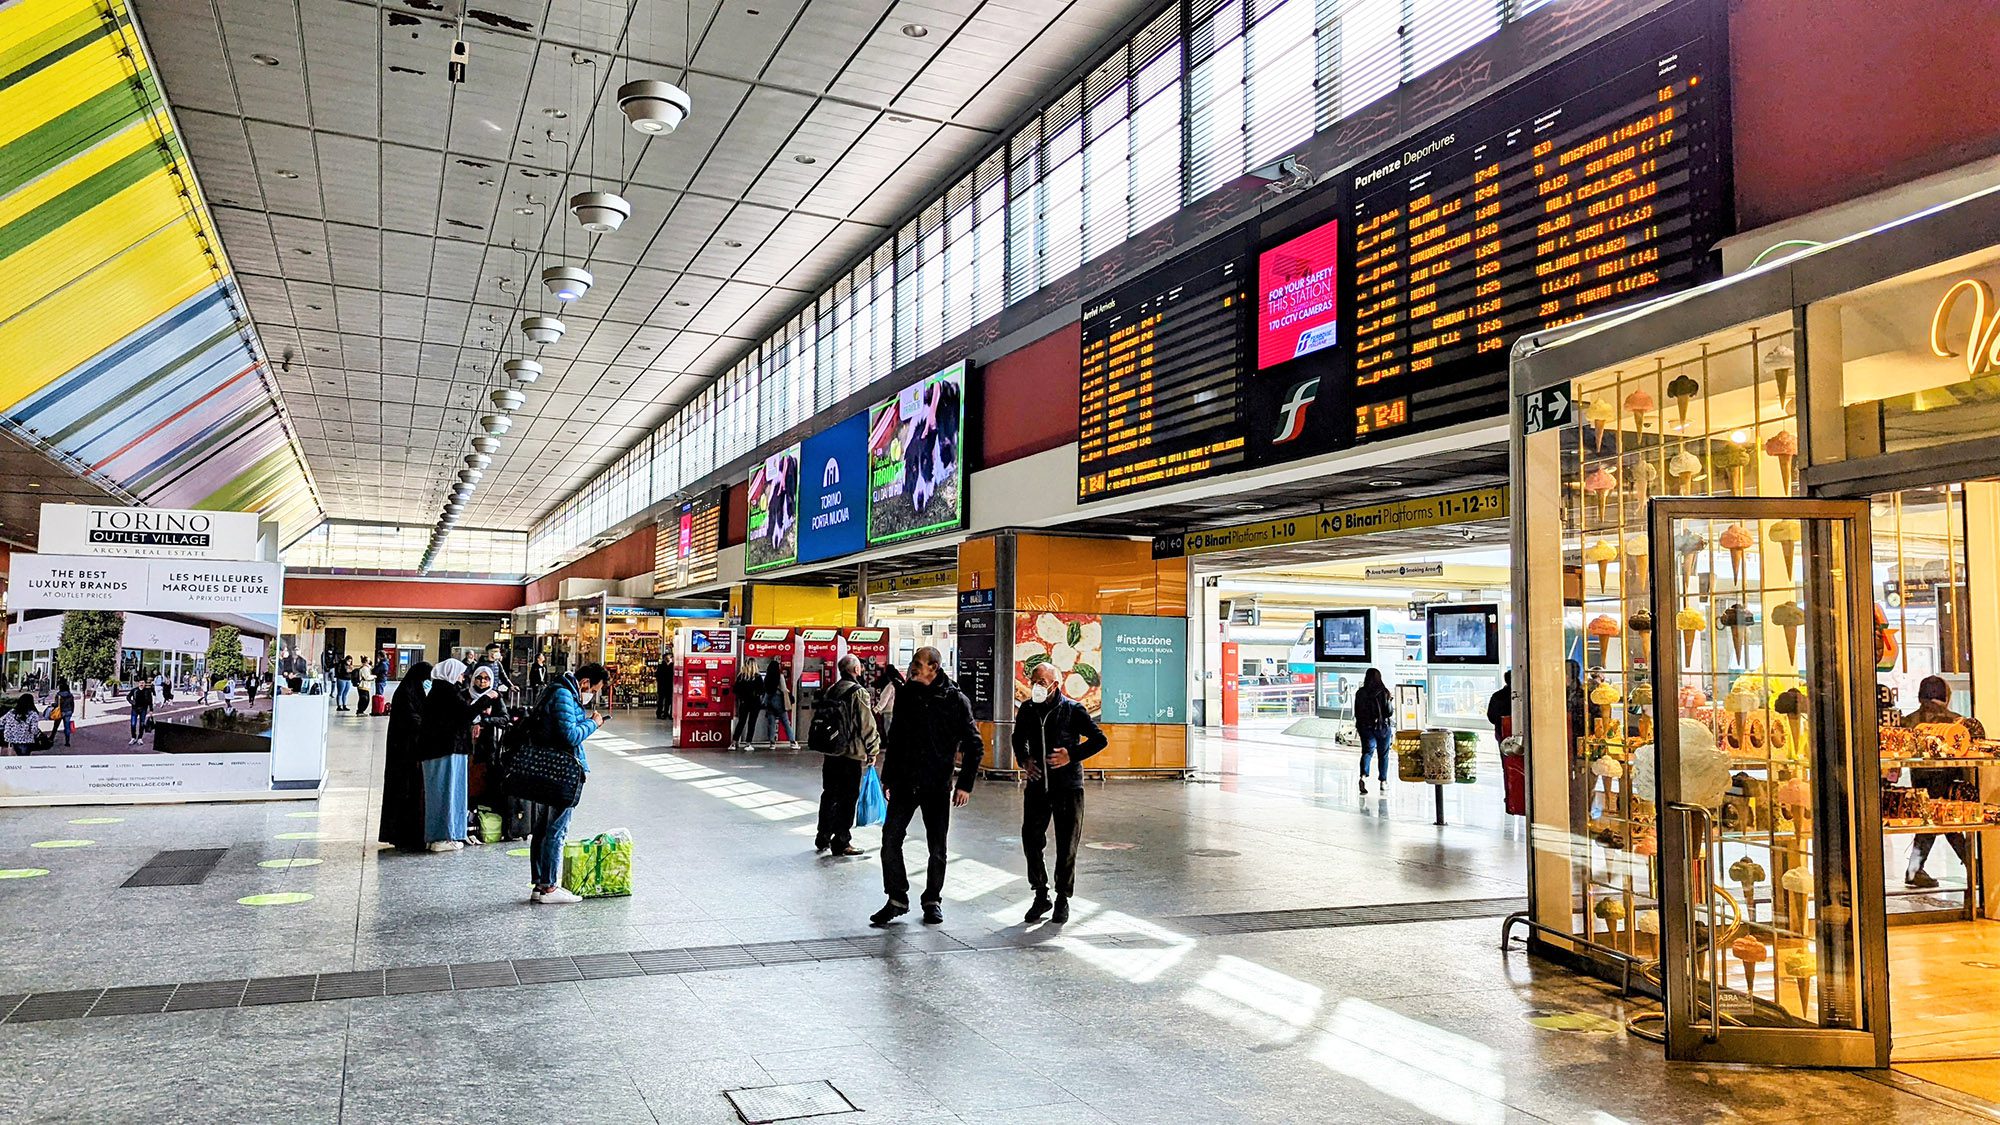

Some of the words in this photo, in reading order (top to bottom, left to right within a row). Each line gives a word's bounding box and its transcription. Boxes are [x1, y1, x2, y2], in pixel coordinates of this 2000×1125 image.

[1659, 130, 1674, 147] 17
[1355, 160, 1400, 190] Partenze
[1404, 133, 1455, 166] Departures
[1474, 182, 1500, 202] 12:54
[1269, 288, 1284, 300] FOR
[1285, 278, 1305, 294] YOUR
[1306, 266, 1333, 284] SAFETY
[1268, 296, 1288, 315] THIS
[1290, 279, 1331, 307] STATION
[1269, 320, 1280, 331] 170
[1281, 312, 1298, 326] CCTV
[1299, 300, 1332, 320] CAMERAS
[1374, 400, 1404, 428] 12:41
[821, 491, 842, 510] TORINO
[92, 510, 210, 533] TORINO
[812, 512, 829, 530] PORTA
[830, 507, 850, 525] NUOVA
[1346, 510, 1382, 528] Binari
[1384, 506, 1433, 524] Platforms
[93, 532, 147, 543] OUTLET
[152, 534, 207, 545] VILLAGE
[1205, 532, 1232, 547] Binari
[1232, 530, 1268, 543] Platforms
[1272, 523, 1295, 538] 1-10
[52, 570, 74, 578] THE
[79, 570, 107, 579] BEST
[170, 574, 189, 582] LES
[194, 574, 264, 584] MEILLEURES
[29, 580, 76, 589] LUXURY
[80, 582, 128, 591] BRANDS
[162, 584, 219, 594] MARQUES
[242, 586, 269, 594] LUXE
[1117, 634, 1172, 646] #instazione
